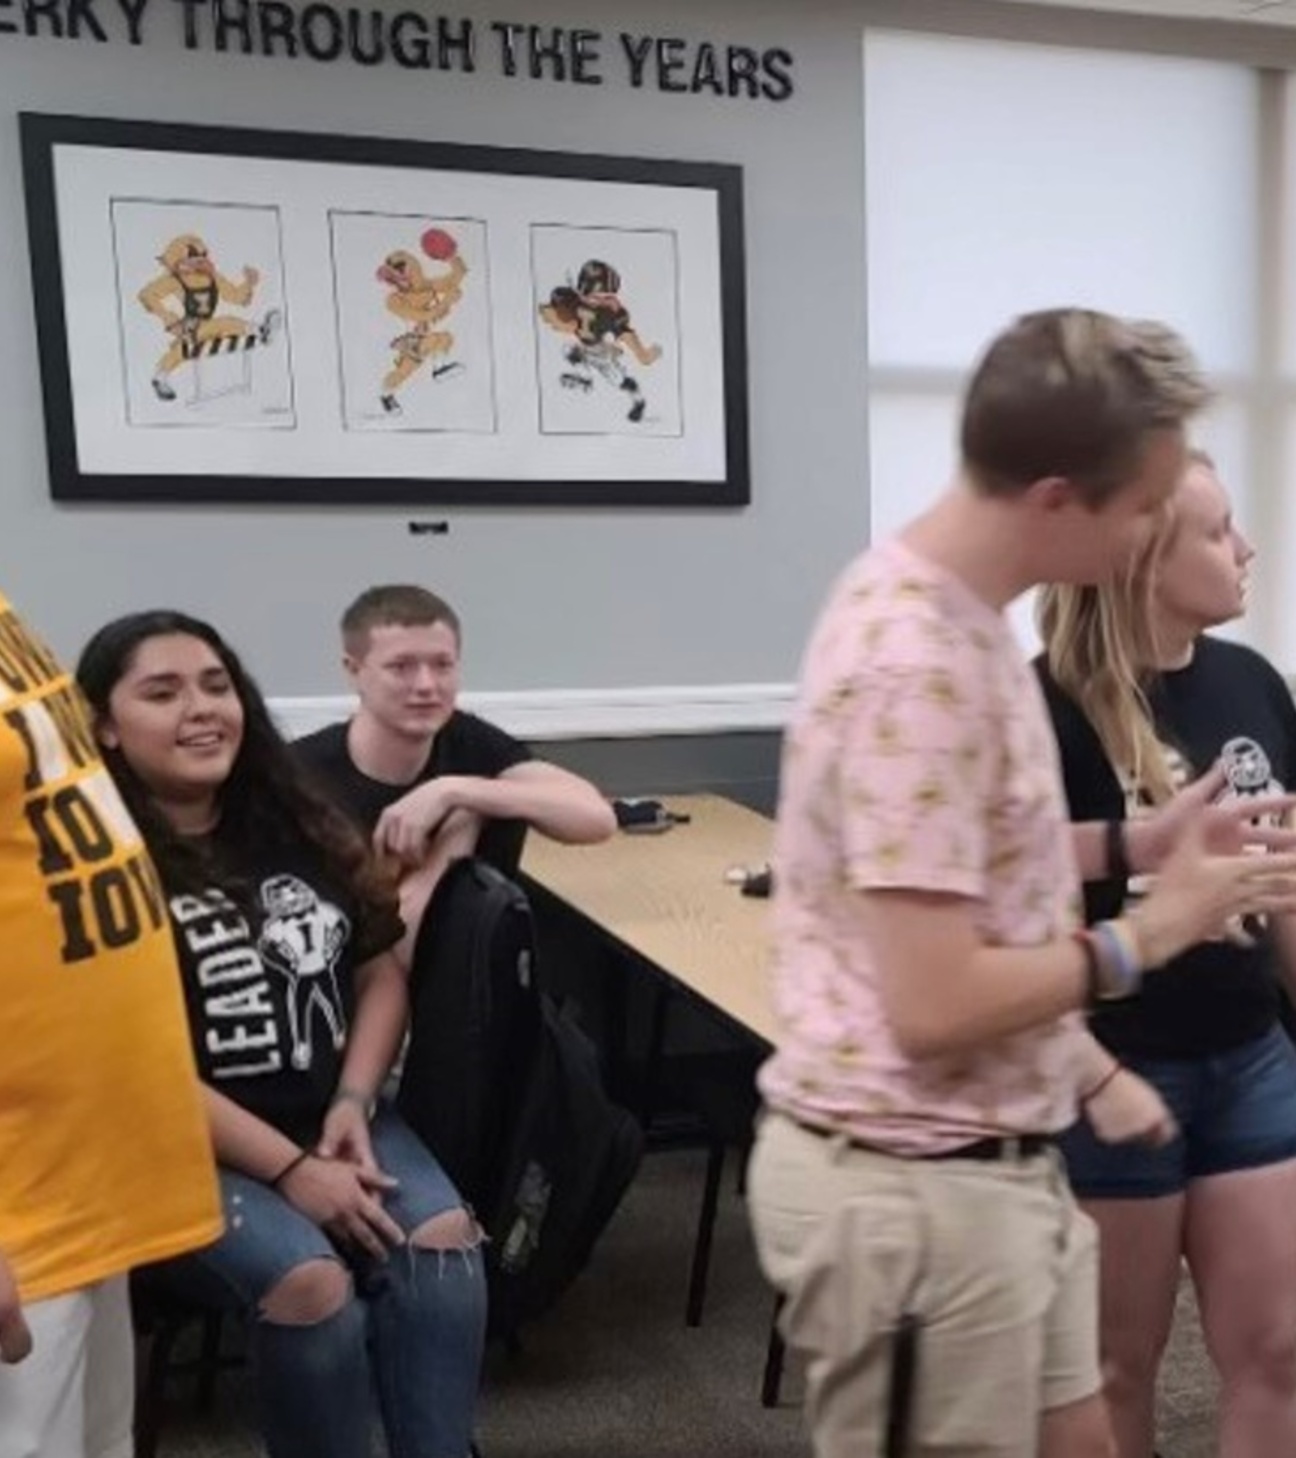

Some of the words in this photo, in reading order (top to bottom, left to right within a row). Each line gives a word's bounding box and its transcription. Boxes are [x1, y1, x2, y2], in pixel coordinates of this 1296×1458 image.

[176, 0, 475, 72] THROUGH
[490, 21, 602, 85] THE
[619, 32, 793, 102] YEARS
